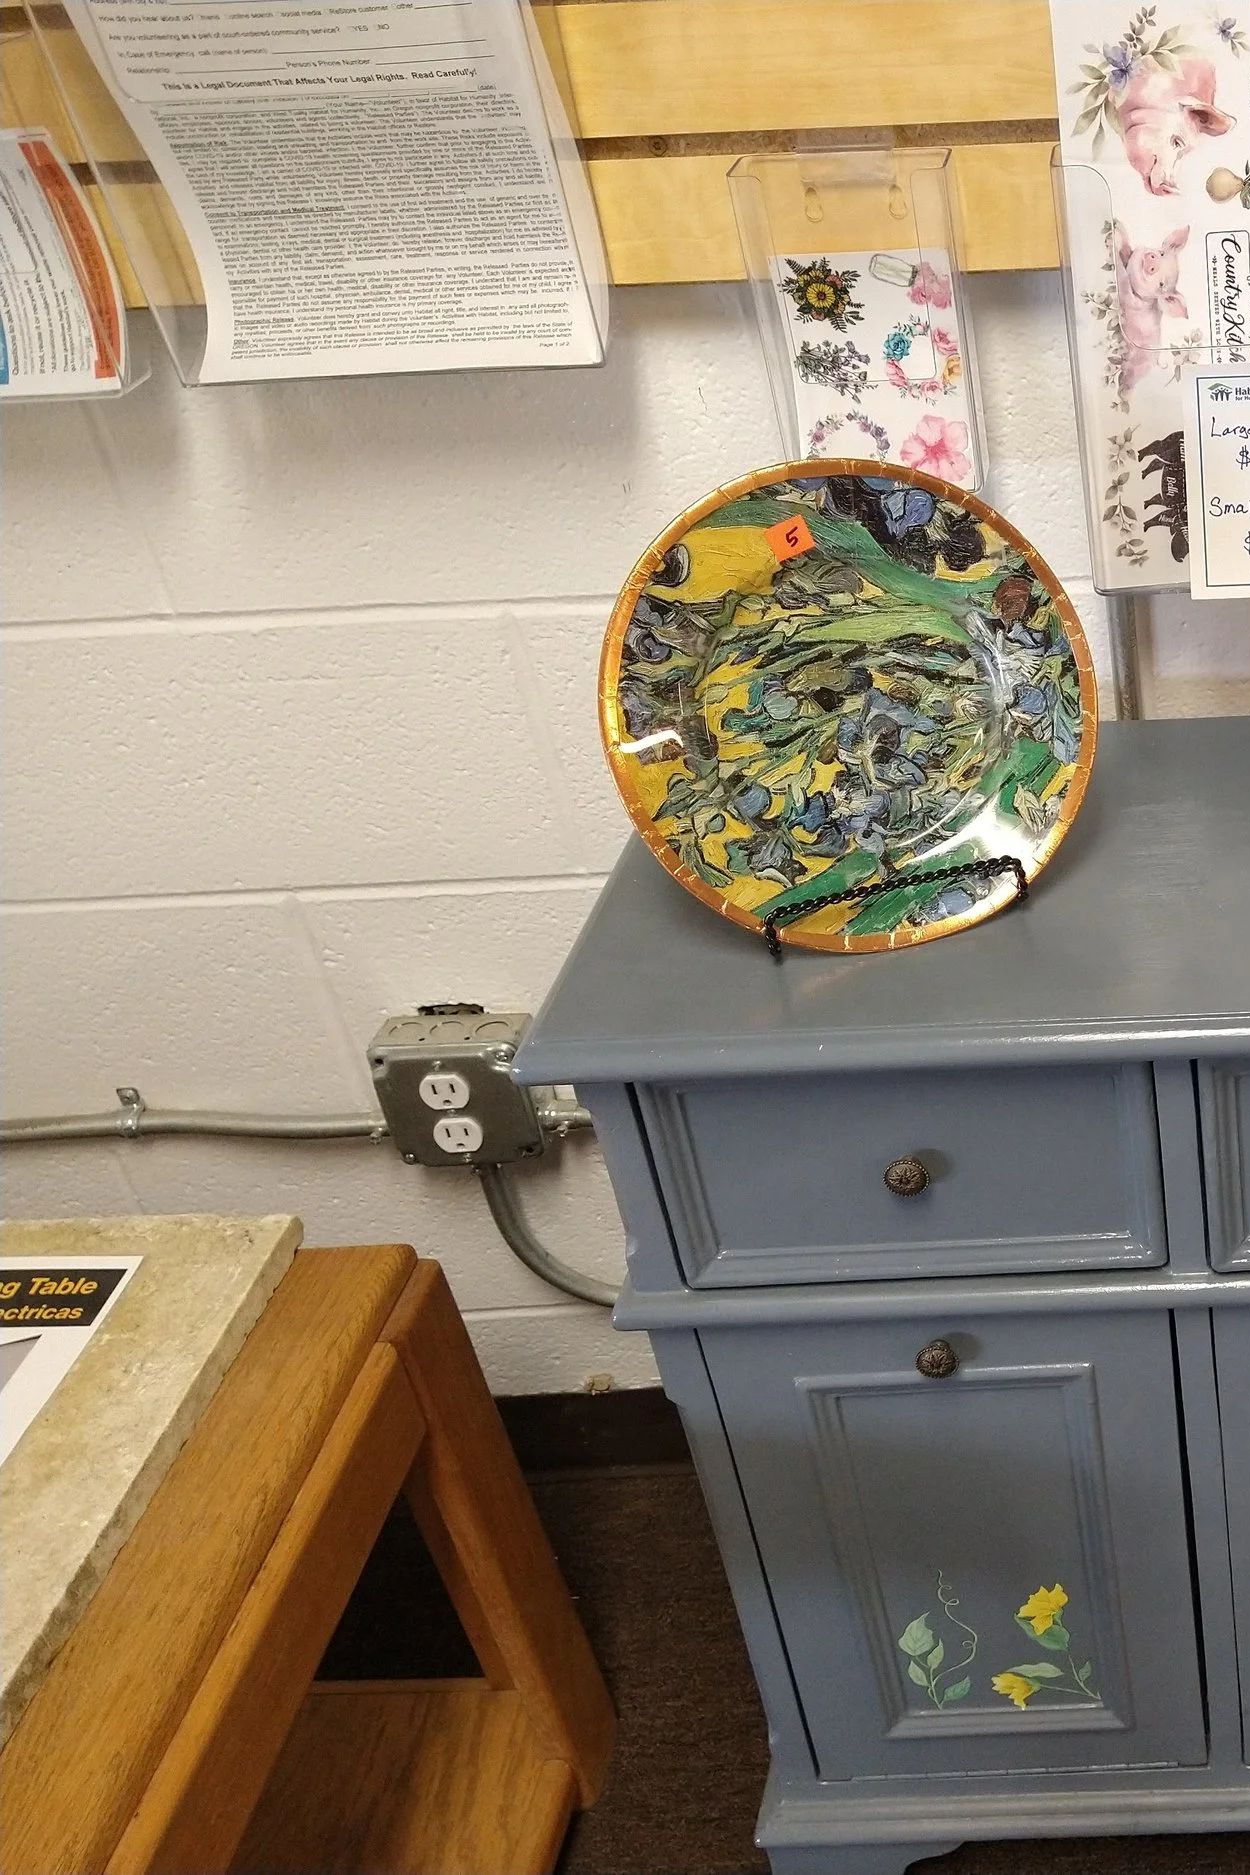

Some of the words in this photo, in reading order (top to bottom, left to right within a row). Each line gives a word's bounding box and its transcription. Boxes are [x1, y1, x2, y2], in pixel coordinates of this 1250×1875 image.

[200, 81, 225, 91] Legal
[226, 79, 272, 89] Document
[273, 78, 294, 87] That
[295, 77, 326, 86] Affects
[327, 75, 348, 84] Your
[350, 74, 375, 84] Legal
[376, 72, 408, 83] Rights.
[411, 71, 434, 80] Read
[1220, 233, 1242, 312] Country
[1166, 476, 1179, 497] Belly
[786, 526, 798, 548] 5
[28, 1277, 98, 1296] Table
